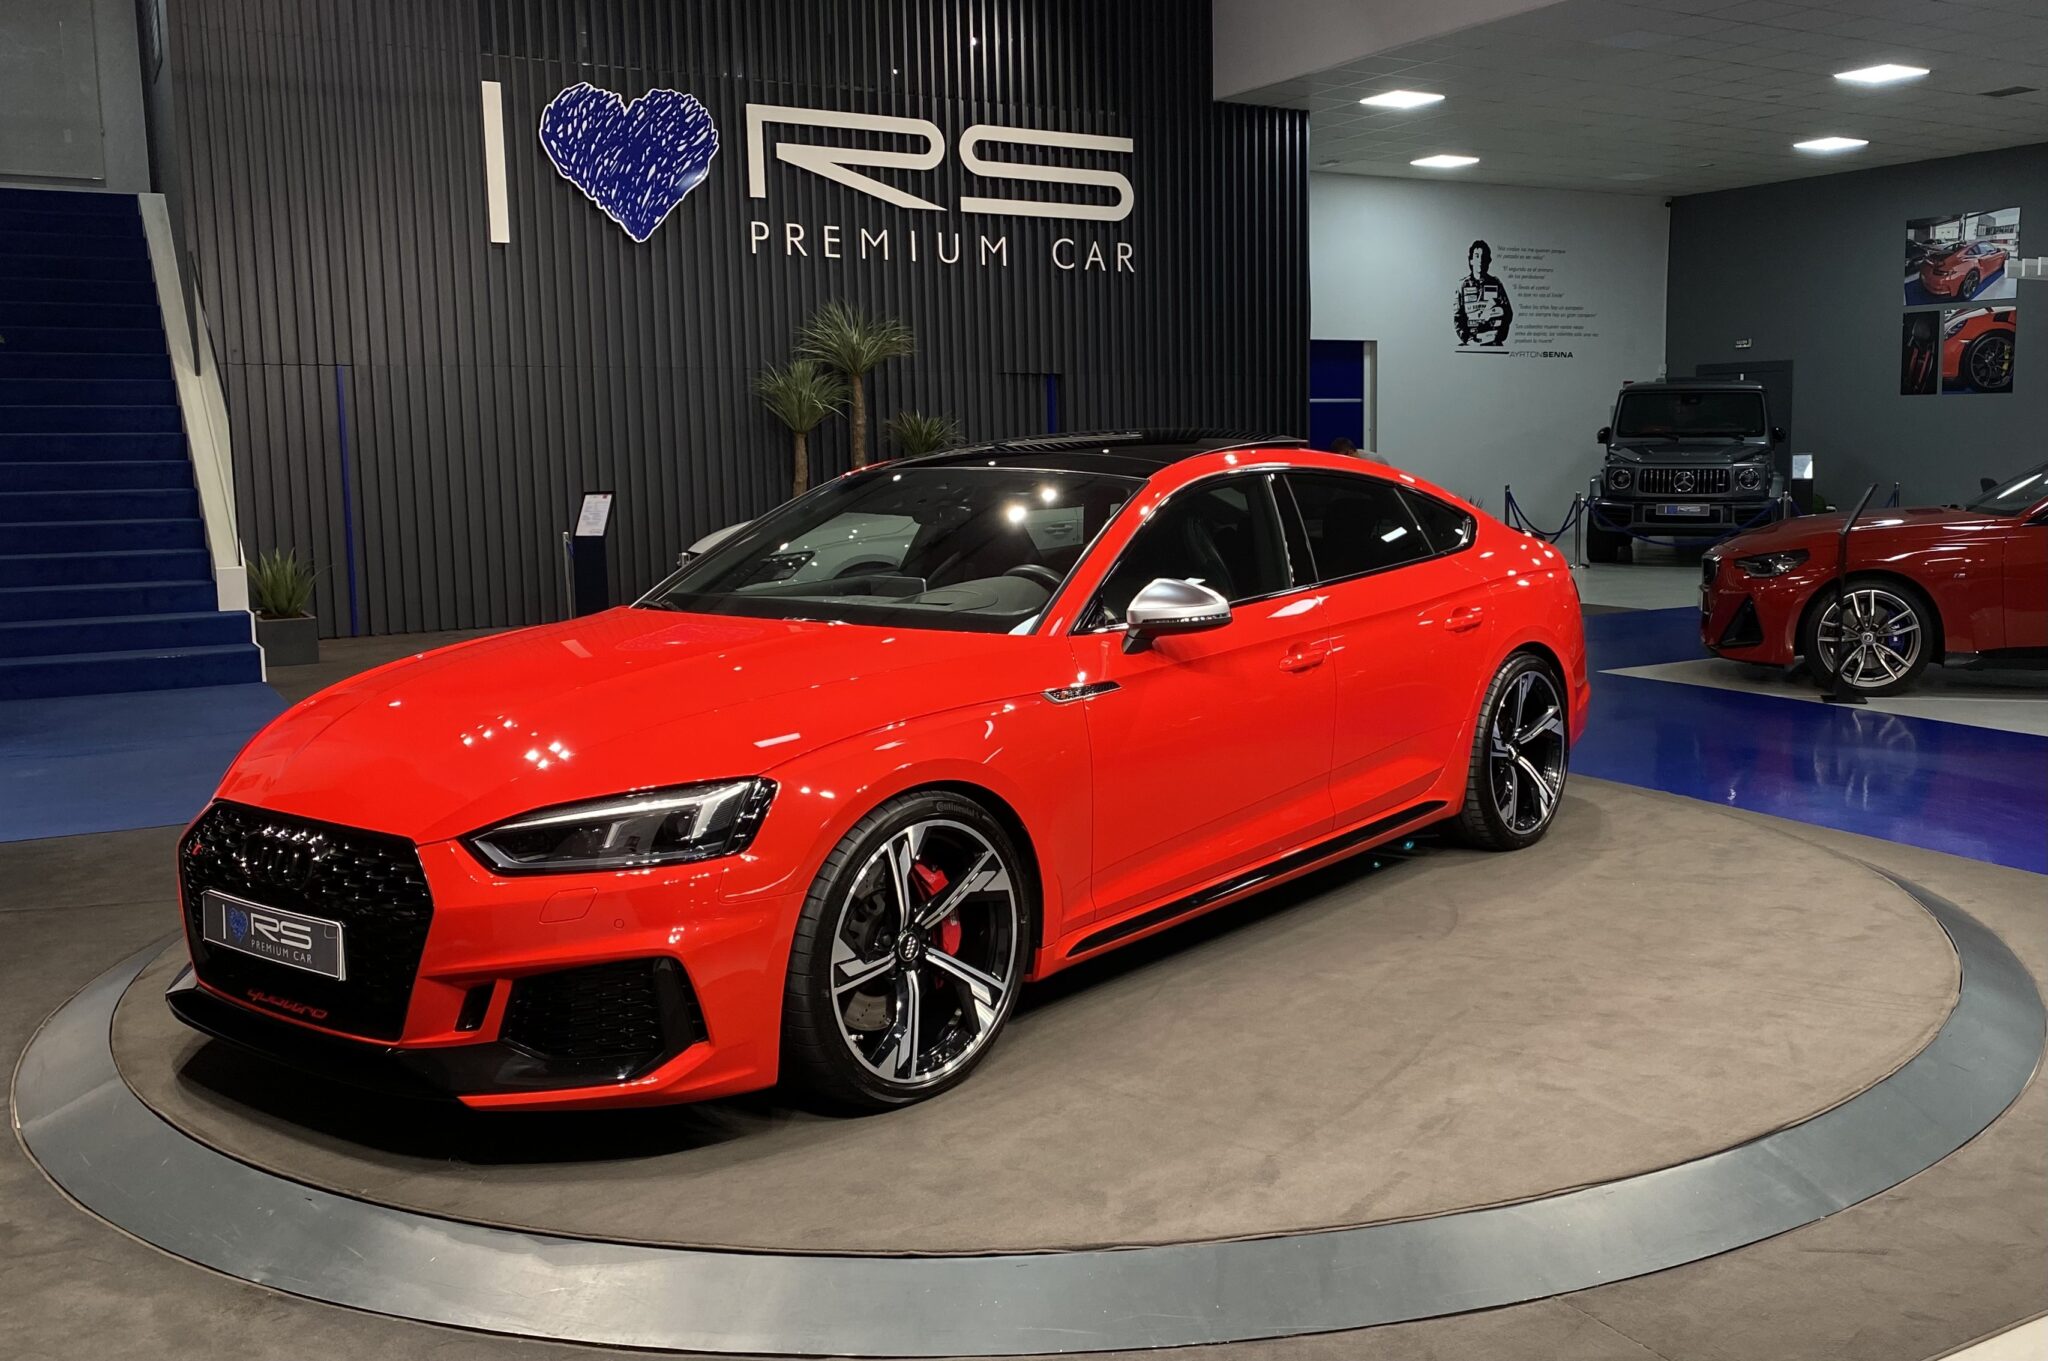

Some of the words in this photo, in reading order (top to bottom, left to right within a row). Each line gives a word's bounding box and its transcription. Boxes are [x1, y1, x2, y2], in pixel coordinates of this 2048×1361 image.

[746, 103, 1135, 221] RS
[751, 220, 1008, 267] PREMIUM
[1052, 237, 1136, 273] CAR
[250, 913, 312, 950] RS
[251, 940, 289, 958] PREMIUM
[293, 951, 313, 964] CAR
